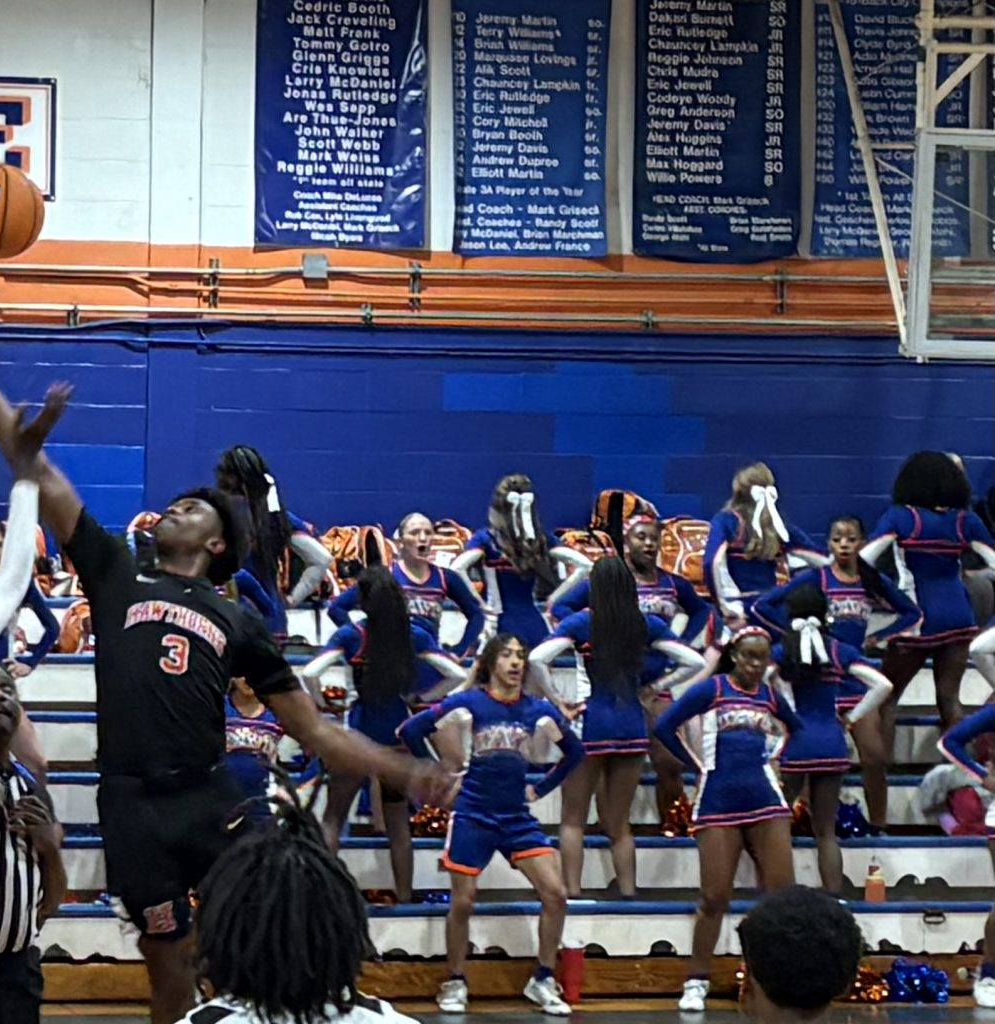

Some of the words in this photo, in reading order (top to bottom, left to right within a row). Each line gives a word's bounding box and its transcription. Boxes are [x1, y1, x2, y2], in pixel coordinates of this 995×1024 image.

[348, 2, 391, 14] Booth
[287, 12, 321, 24] Jack
[521, 15, 557, 26] Martin
[768, 15, 786, 27] SO
[340, 27, 380, 39] Frank
[476, 25, 504, 38] Terry
[648, 25, 672, 36] Eric
[676, 26, 728, 39] Rutledge
[293, 37, 343, 53] Tommy
[508, 40, 555, 52] Williams
[292, 50, 335, 62] Glenn
[767, 55, 784, 67] SR
[500, 65, 531, 77] Scott
[766, 68, 784, 81] SR
[285, 74, 323, 89] Larry
[329, 76, 396, 89] McDaniel
[647, 78, 669, 90] Eric
[766, 82, 784, 95] SR
[332, 88, 397, 104] Rutledge
[473, 90, 495, 101] Eric
[500, 91, 551, 104] Rutledge
[305, 100, 333, 112] Wes
[339, 101, 376, 116] Sapp
[473, 103, 495, 114] Eric
[647, 105, 675, 118] Greg
[680, 106, 735, 119] Anderson
[765, 108, 784, 120] SO
[472, 115, 501, 129] Cory
[646, 118, 690, 131] Jeremy
[765, 121, 783, 134] SR
[294, 124, 330, 137] John
[334, 126, 384, 139] Walker
[472, 128, 505, 141] Bryan
[509, 130, 543, 141] Booth
[298, 136, 336, 149] Scott
[341, 138, 380, 151] Webb
[472, 141, 514, 154] Jeremy
[517, 143, 549, 154] Davis
[298, 149, 332, 161] Mark
[683, 145, 720, 157] Martin
[764, 148, 783, 160] SR
[472, 155, 514, 165] Andrew
[646, 158, 669, 169] Max
[764, 161, 783, 173] SO
[277, 161, 327, 176] Reggie
[508, 168, 544, 180] Martin
[477, 204, 514, 214] Coach
[527, 204, 555, 215] Mark
[476, 216, 522, 227] Coaches
[570, 219, 599, 228] Scott
[514, 241, 551, 250] Andrew
[159, 633, 190, 675] 3
